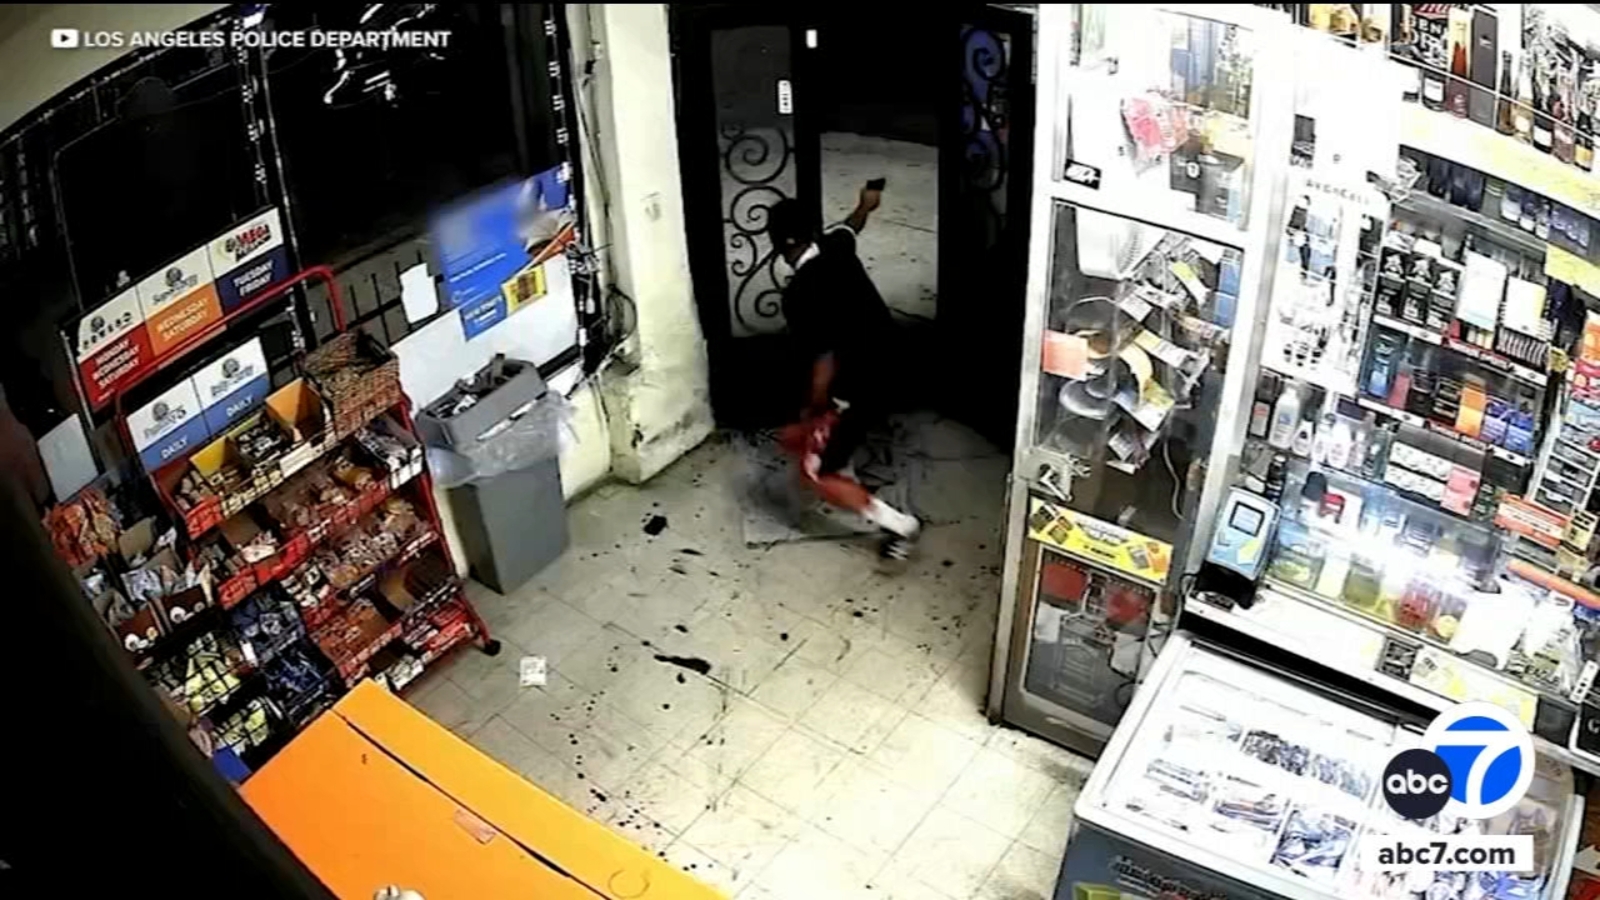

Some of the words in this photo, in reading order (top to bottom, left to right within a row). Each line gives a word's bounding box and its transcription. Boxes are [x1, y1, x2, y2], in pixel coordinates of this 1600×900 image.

[233, 260, 274, 288] TUESDAY
[239, 272, 273, 296] FRIDAY
[156, 298, 209, 334] WEDNESDAY
[161, 311, 208, 341] SATURDAY
[91, 344, 140, 380] WEDNESDAY
[94, 338, 130, 366] MONDAY
[97, 356, 140, 389] SATURDAY
[226, 395, 254, 418] DAILY
[161, 436, 188, 459] DAILY
